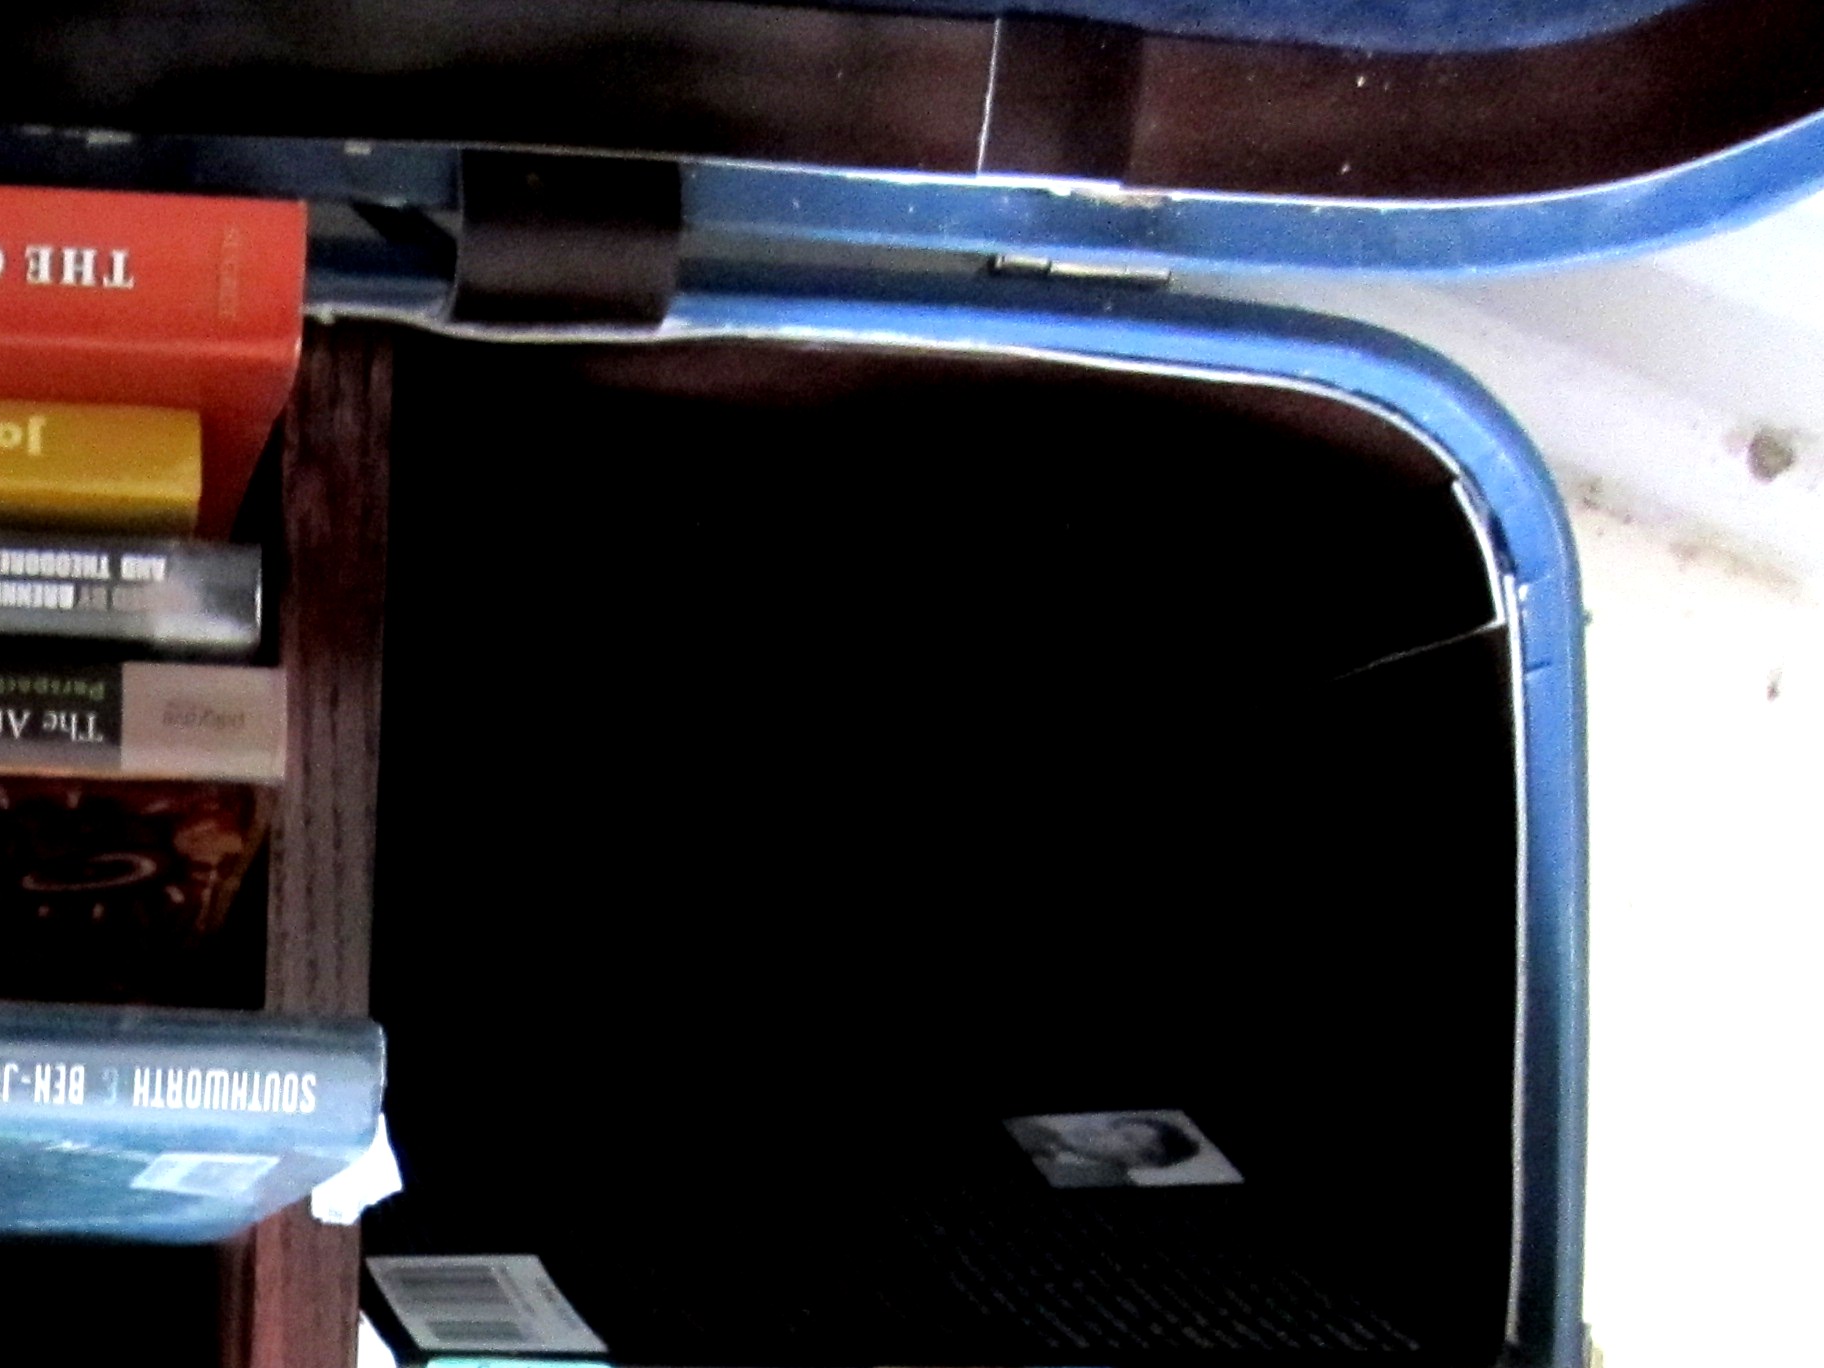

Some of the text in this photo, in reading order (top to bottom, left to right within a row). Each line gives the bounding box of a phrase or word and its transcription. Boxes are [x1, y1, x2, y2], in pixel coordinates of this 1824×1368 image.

[23, 245, 135, 290] THE
[120, 553, 167, 583] AND
[41, 708, 103, 743] The
[133, 1067, 318, 1114] SOUTHWORTH
